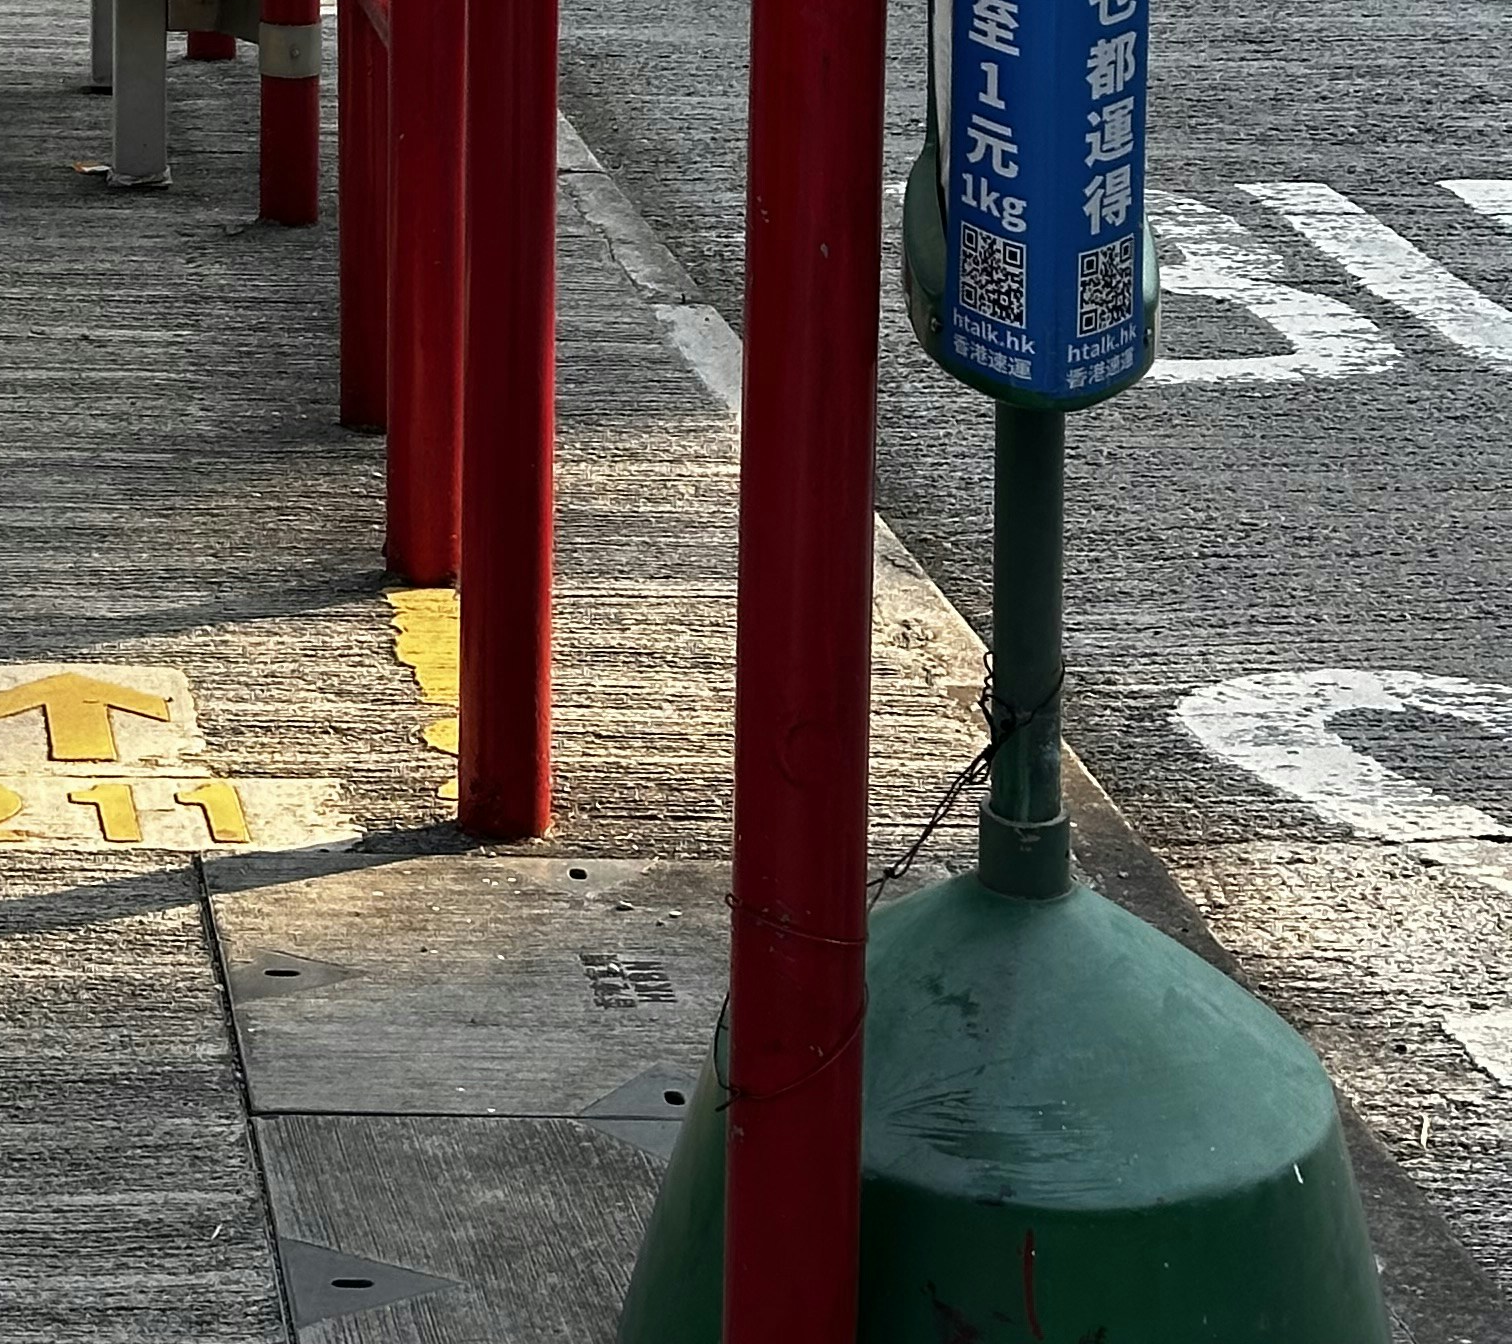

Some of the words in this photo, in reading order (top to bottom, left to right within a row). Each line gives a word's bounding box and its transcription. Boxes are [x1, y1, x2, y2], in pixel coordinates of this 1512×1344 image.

[960, 172, 1028, 234] 1kg
[952, 307, 1037, 355] htalk.hk
[1066, 323, 1138, 364] htalk.hk
[952, 334, 1032, 381] 香港速運
[1065, 346, 1135, 390] 香港速運
